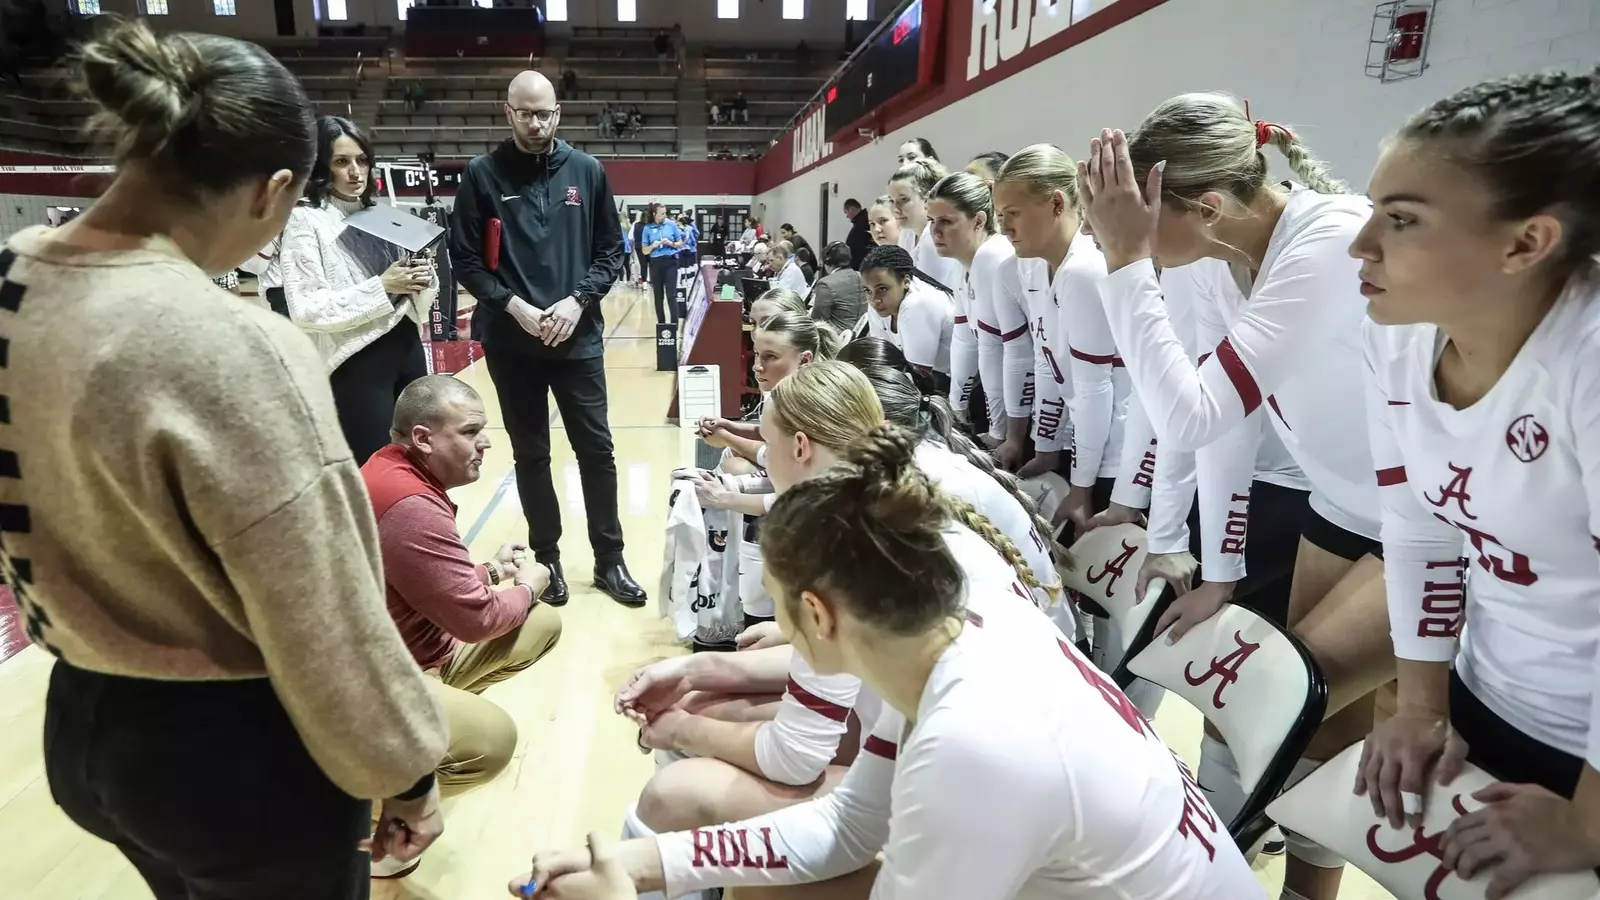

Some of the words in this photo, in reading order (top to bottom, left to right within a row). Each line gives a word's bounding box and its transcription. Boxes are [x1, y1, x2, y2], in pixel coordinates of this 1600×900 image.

[1037, 397, 1065, 441] ROLL
[1132, 438, 1157, 488] ROL
[1220, 487, 1251, 555] ROLL
[1417, 556, 1464, 637] ROLL
[691, 827, 789, 869] ROLL
